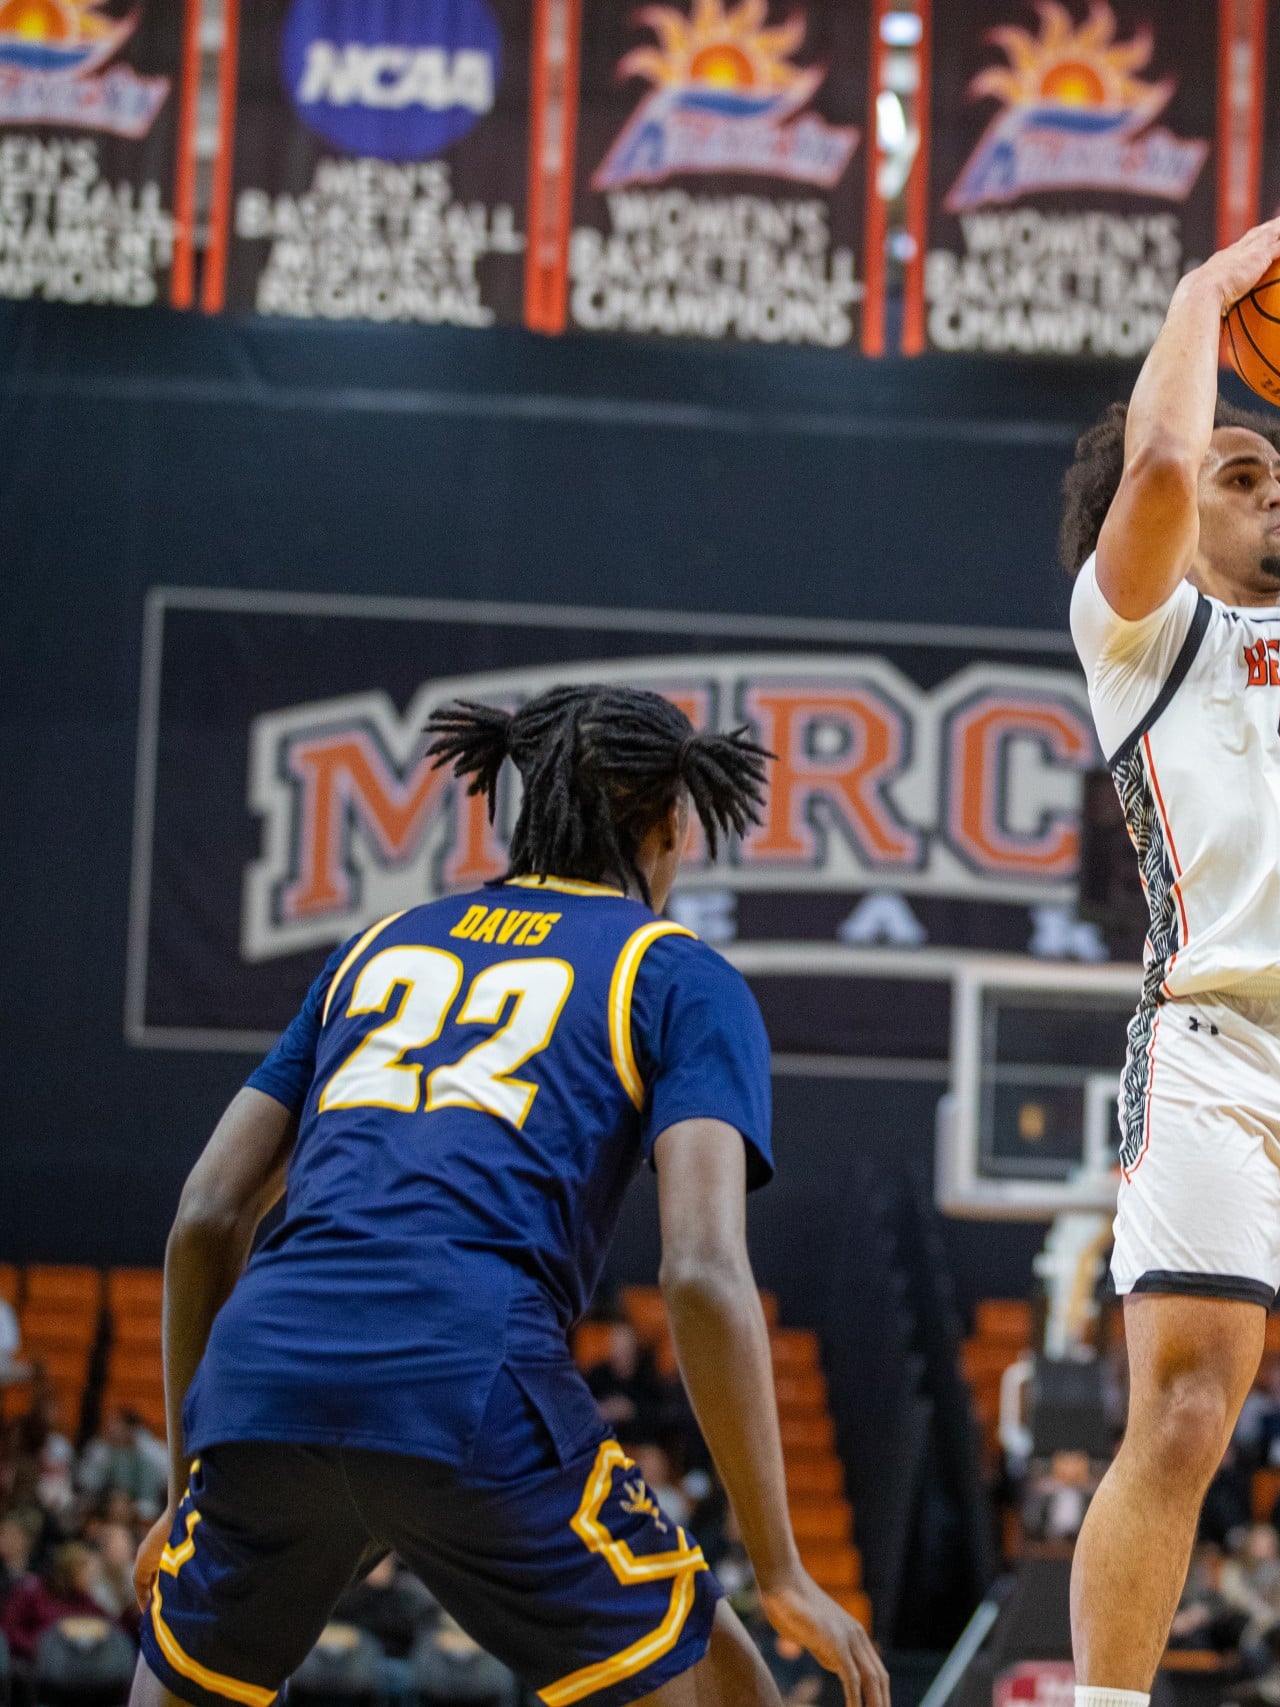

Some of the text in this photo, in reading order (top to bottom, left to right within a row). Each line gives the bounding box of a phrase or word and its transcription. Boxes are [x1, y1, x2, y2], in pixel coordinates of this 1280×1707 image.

[303, 40, 495, 114] NCAA
[607, 188, 830, 254] WOMEN'S
[960, 208, 1181, 272] WOMEN'S
[568, 225, 866, 304] BASKETBALL
[570, 280, 853, 347] CHAMPIONS
[449, 904, 562, 946] DAVIS
[318, 944, 575, 1131] 22
